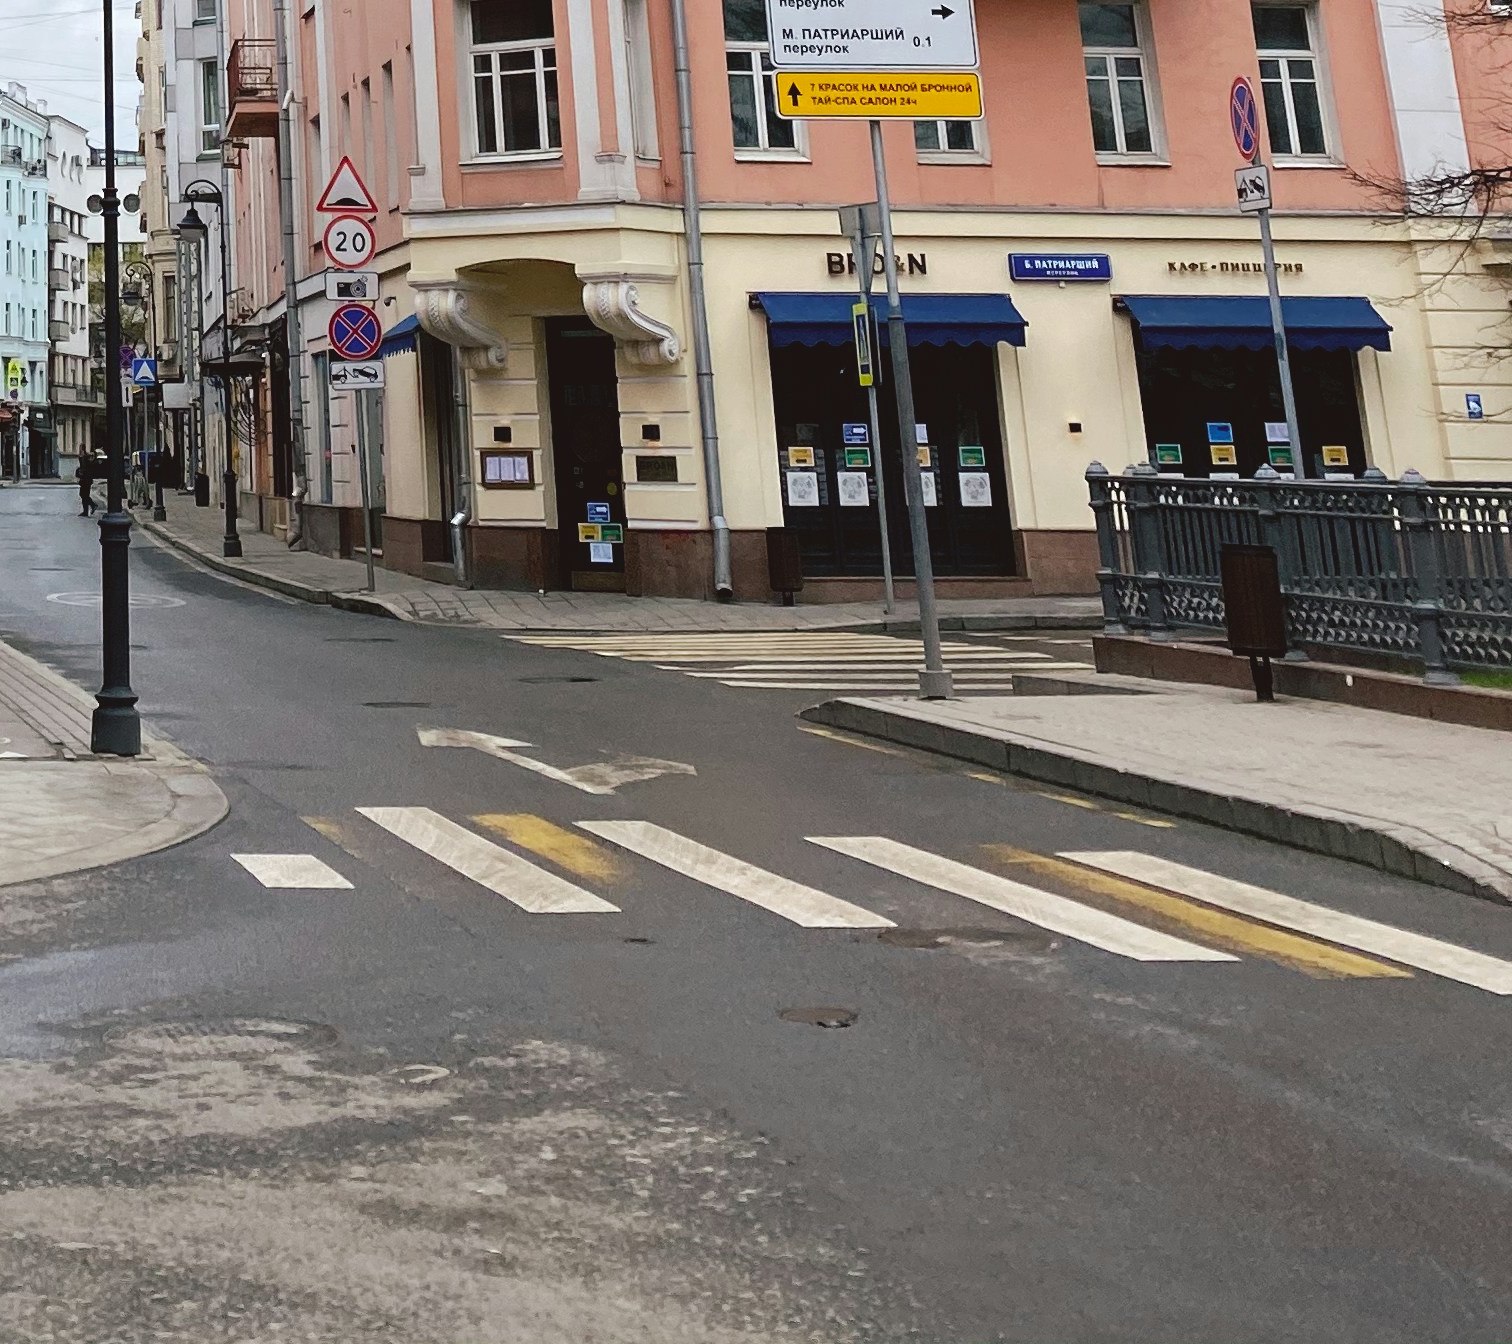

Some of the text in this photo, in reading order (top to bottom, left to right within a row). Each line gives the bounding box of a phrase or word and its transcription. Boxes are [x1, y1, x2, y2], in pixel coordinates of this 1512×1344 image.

[782, 27, 932, 47] М. ПАТРИАРШИЙ 0.1
[783, 44, 849, 56] переулок
[818, 83, 859, 92] КРАСОК
[862, 84, 876, 92] НА
[879, 82, 918, 92] МАЛОЙ
[920, 82, 973, 93] БРОННОЙ
[811, 96, 857, 106] ТАЙ-СПА
[860, 97, 897, 106] САЛОН
[335, 231, 366, 253] 20
[1035, 258, 1099, 269] ПАТРИАРШИЙ
[1219, 262, 1303, 273] ПИЦЦРИЯ
